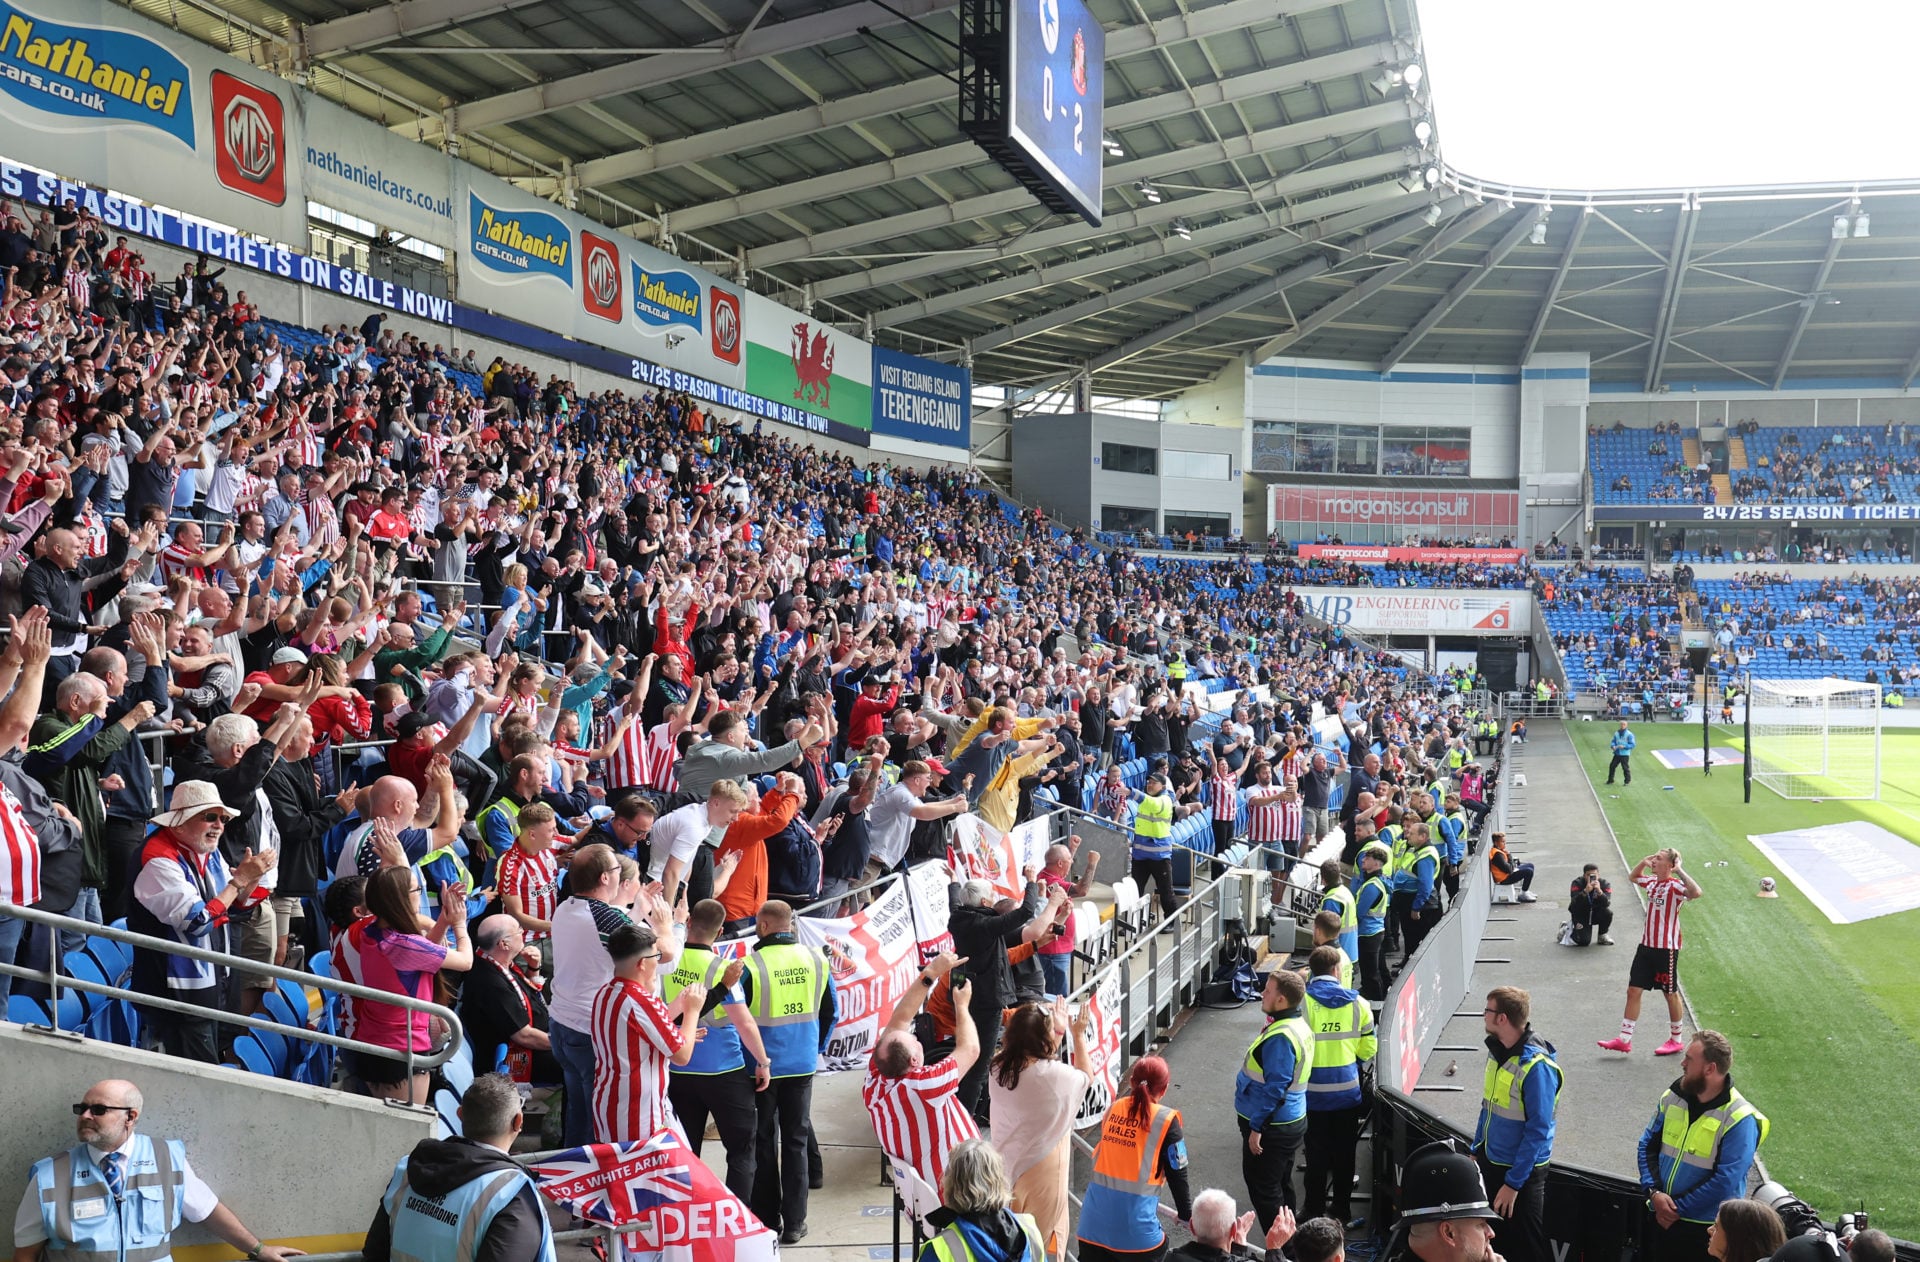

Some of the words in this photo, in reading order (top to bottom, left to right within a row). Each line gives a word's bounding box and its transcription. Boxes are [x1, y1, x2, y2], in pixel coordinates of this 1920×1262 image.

[0, 14, 183, 117] Nathaniel
[0, 61, 105, 113] cars.co.uk
[1042, 65, 1053, 122] 0
[1074, 102, 1083, 156] 2
[230, 106, 269, 173] MG
[307, 146, 454, 220] nathanielcars.co.uk
[36, 174, 165, 240] SEASON
[175, 218, 292, 278] TICKETS
[301, 255, 331, 290] ON
[339, 266, 396, 308] SALE
[402, 286, 454, 326] NOW!
[477, 208, 569, 267] Nathaniel
[475, 240, 529, 270] cars.co.uk
[590, 256, 617, 301] MG
[638, 272, 699, 318] Nathaniel
[636, 301, 671, 322] cars.co.uk
[716, 308, 736, 345] MG
[631, 359, 671, 388] 24/25
[674, 371, 718, 402] SEASON
[721, 386, 764, 416] TICKETS
[766, 400, 779, 420] ON
[781, 405, 804, 427] SALE
[806, 412, 828, 434] NOW!
[880, 363, 901, 386] VISIT
[902, 369, 933, 394] REDANG
[934, 376, 961, 400] ISLAND
[880, 387, 961, 432] TERENGGANU
[1324, 496, 1470, 519] morgansconsult
[1703, 506, 1764, 520] 24/25
[1769, 506, 1845, 520] SEASON
[1321, 548, 1390, 560] morgansconsult
[1355, 596, 1461, 611] ENGINEERING
[1378, 610, 1429, 619] SUPPORTING
[1404, 618, 1430, 627] SPORT
[672, 968, 700, 981] UBICON
[774, 967, 810, 978] RUBICON
[779, 976, 806, 986] WALES
[783, 1002, 804, 1015] 383
[836, 983, 866, 1024] DID
[869, 975, 884, 1012] IT
[1321, 1022, 1341, 1032] 275
[1102, 1134, 1137, 1149] SUPERVISOR
[1108, 1123, 1137, 1139] WALES
[573, 1181, 586, 1193] &
[586, 1165, 632, 1188] WHITE
[634, 1153, 670, 1173] ARMY
[405, 1196, 459, 1227] SAFEGUARDING
